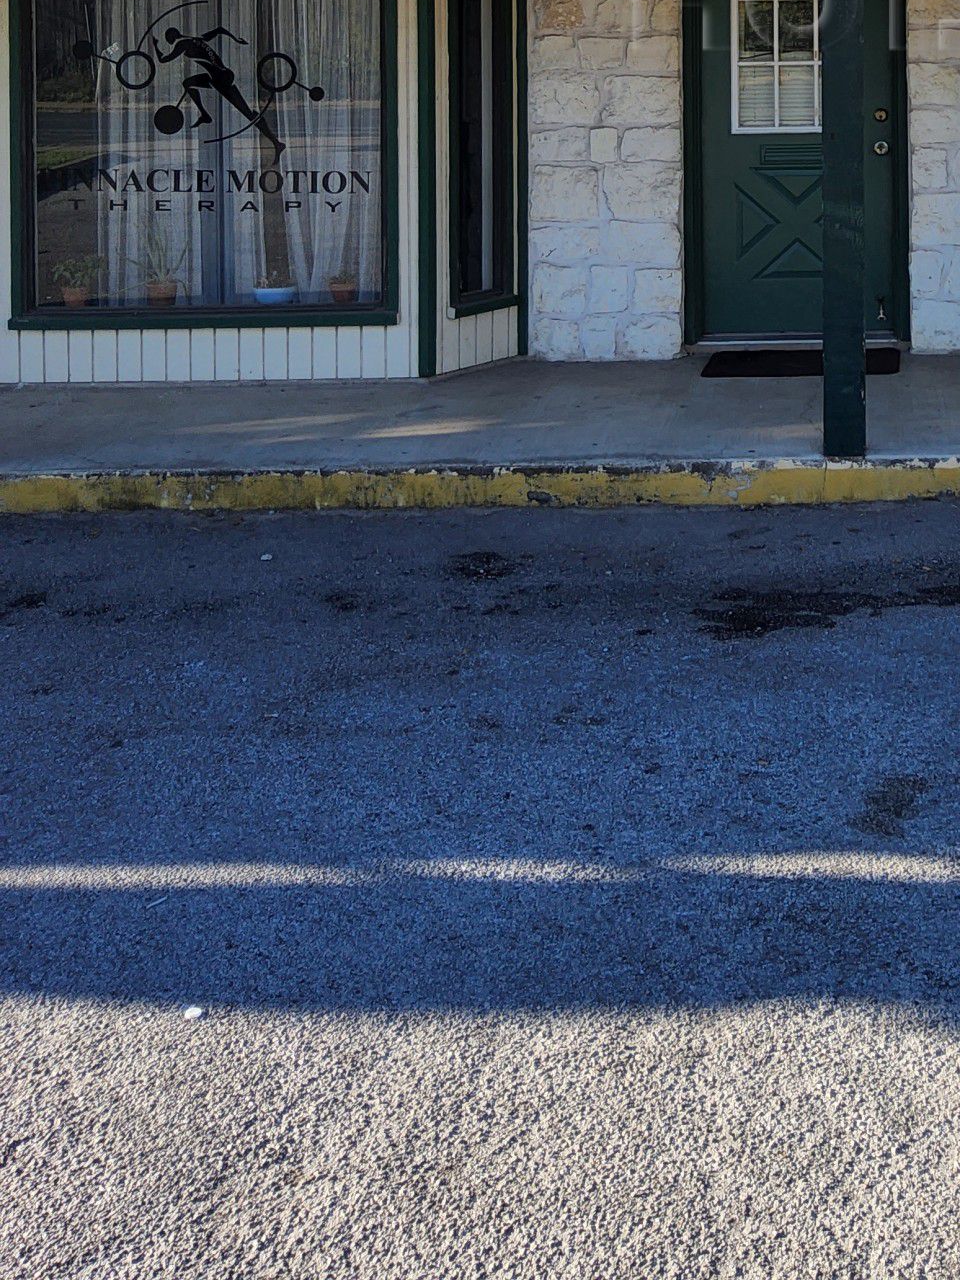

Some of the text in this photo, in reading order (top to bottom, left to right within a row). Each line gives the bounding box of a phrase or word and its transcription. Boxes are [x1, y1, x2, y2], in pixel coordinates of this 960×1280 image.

[43, 168, 374, 195] INNACLE MOTION
[67, 198, 344, 213] THERAPY
